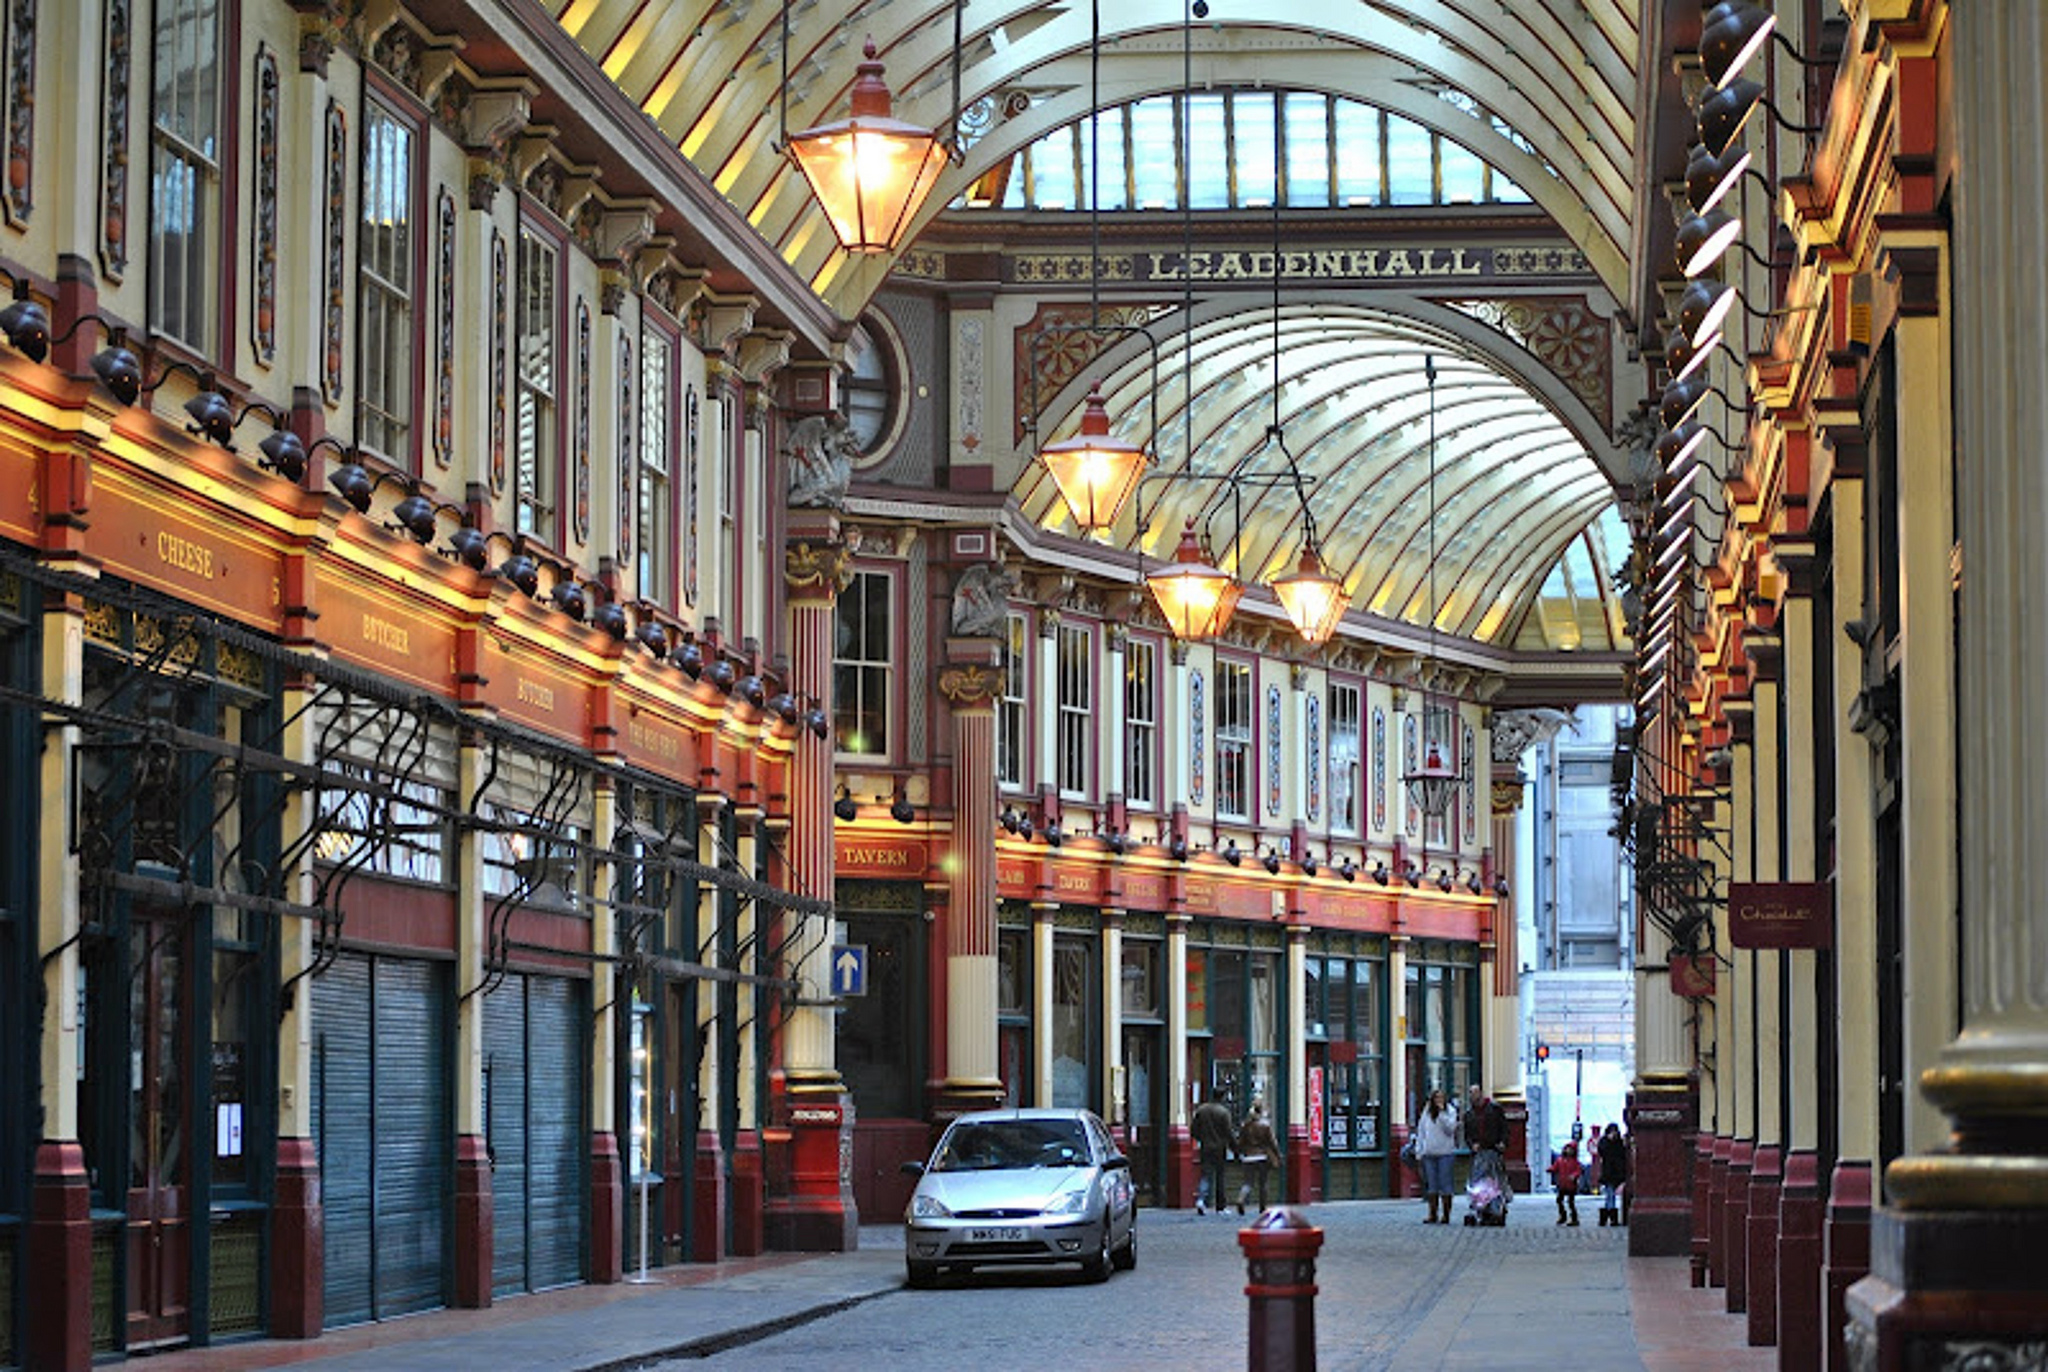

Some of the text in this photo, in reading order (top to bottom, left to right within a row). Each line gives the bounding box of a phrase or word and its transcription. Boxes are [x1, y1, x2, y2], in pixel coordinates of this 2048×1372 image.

[1148, 248, 1481, 281] LEADENHALL
[157, 531, 214, 580] CHEESE
[362, 613, 410, 655] BUTCHER
[844, 847, 908, 866] TAVERN
